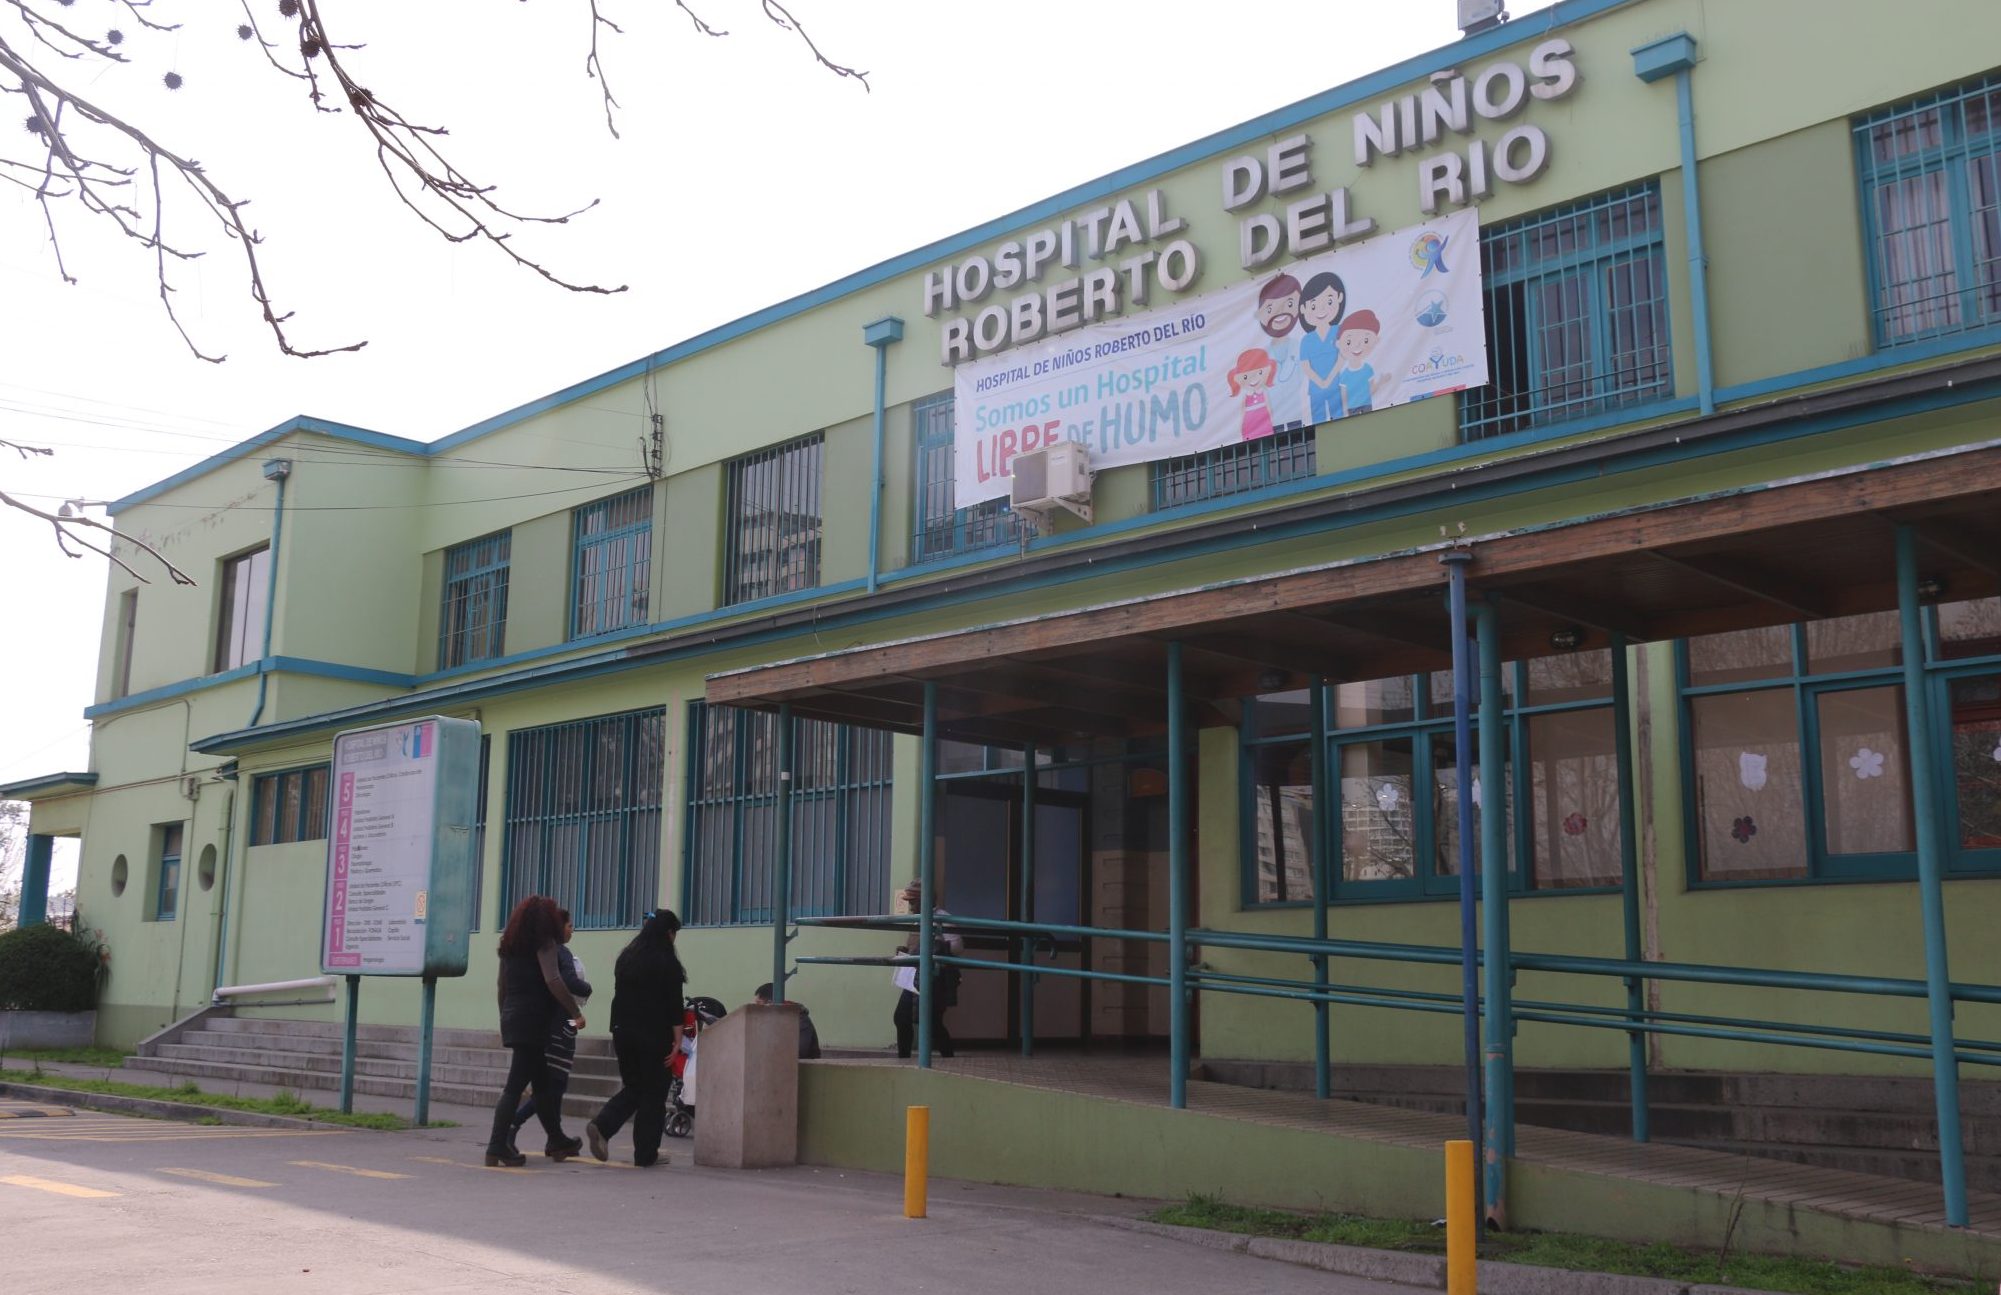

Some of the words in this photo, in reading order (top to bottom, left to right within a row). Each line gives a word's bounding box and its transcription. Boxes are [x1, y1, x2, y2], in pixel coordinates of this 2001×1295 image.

[923, 188, 1190, 318] HOSPITAL
[1222, 134, 1315, 213] DE
[1353, 38, 1580, 167] NIÑOS
[941, 239, 1200, 367] ROBERTO
[1240, 187, 1378, 271] DEL
[1418, 124, 1552, 215] RIO
[975, 393, 1050, 433] Somos
[1058, 383, 1089, 409] un
[1097, 345, 1208, 400] Hospital
[976, 365, 1031, 393] HOSPITAL
[1033, 359, 1050, 376] DE
[1052, 347, 1092, 371] NIÑOS
[1094, 331, 1151, 359] ROBERTO
[1153, 324, 1179, 342] DEL
[1181, 313, 1206, 335] RÍO
[1099, 382, 1208, 455] HUMO
[337, 854, 346, 874] 3
[340, 817, 348, 839] 4
[335, 891, 344, 911] 2
